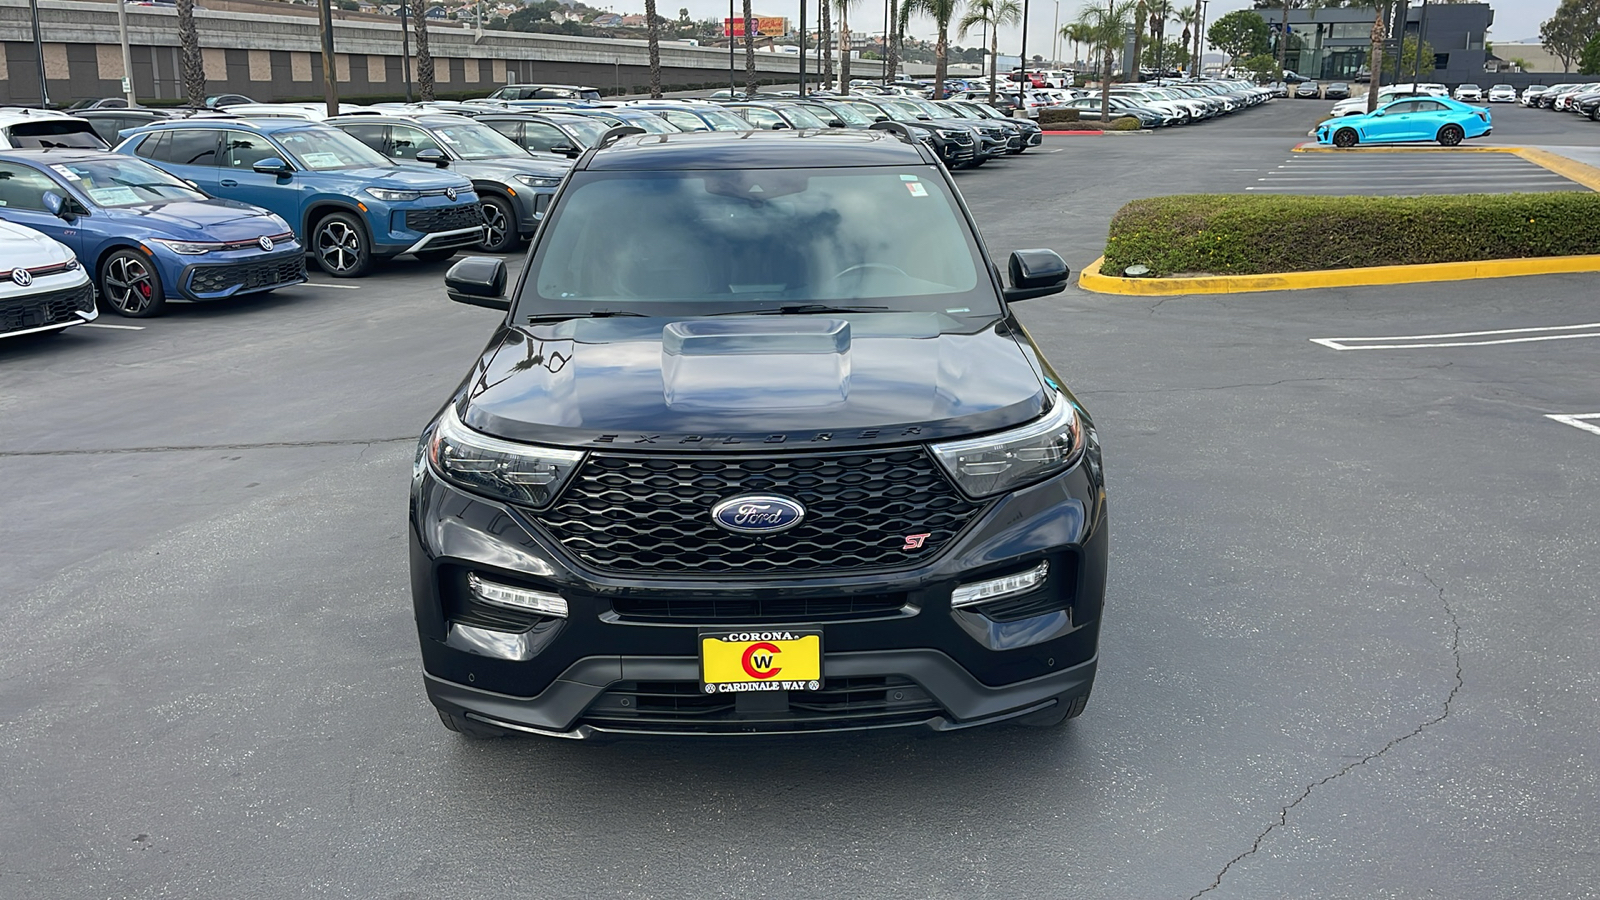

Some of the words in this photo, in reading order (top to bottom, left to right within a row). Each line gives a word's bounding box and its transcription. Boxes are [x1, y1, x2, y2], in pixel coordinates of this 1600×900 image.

[593, 425, 922, 444] EXPLORER
[734, 504, 783, 525] Ford
[902, 532, 931, 550] ST
[728, 631, 793, 642] CORONA
[719, 681, 779, 693] CARDINALE
[781, 681, 806, 691] WAY
